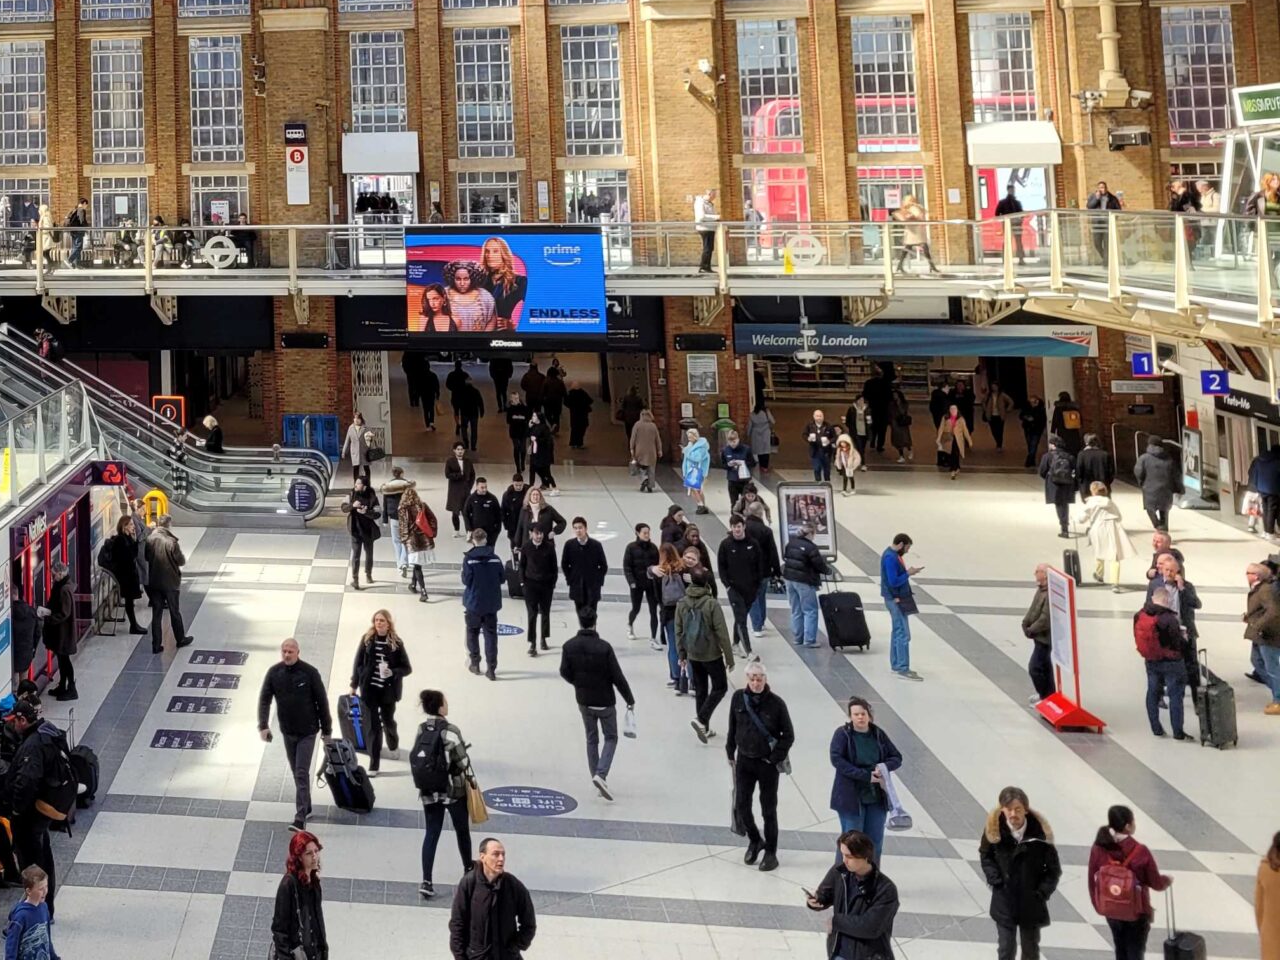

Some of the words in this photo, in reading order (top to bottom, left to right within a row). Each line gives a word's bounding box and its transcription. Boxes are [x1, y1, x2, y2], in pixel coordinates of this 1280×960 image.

[293, 151, 302, 162] B
[544, 243, 581, 258] prime
[529, 308, 600, 319] ENDLESS
[752, 334, 803, 346] Welcome
[807, 335, 819, 346] to
[822, 334, 868, 346] London
[1140, 356, 1149, 372] 1
[1209, 373, 1222, 391] 2
[494, 801, 566, 811] Customer
